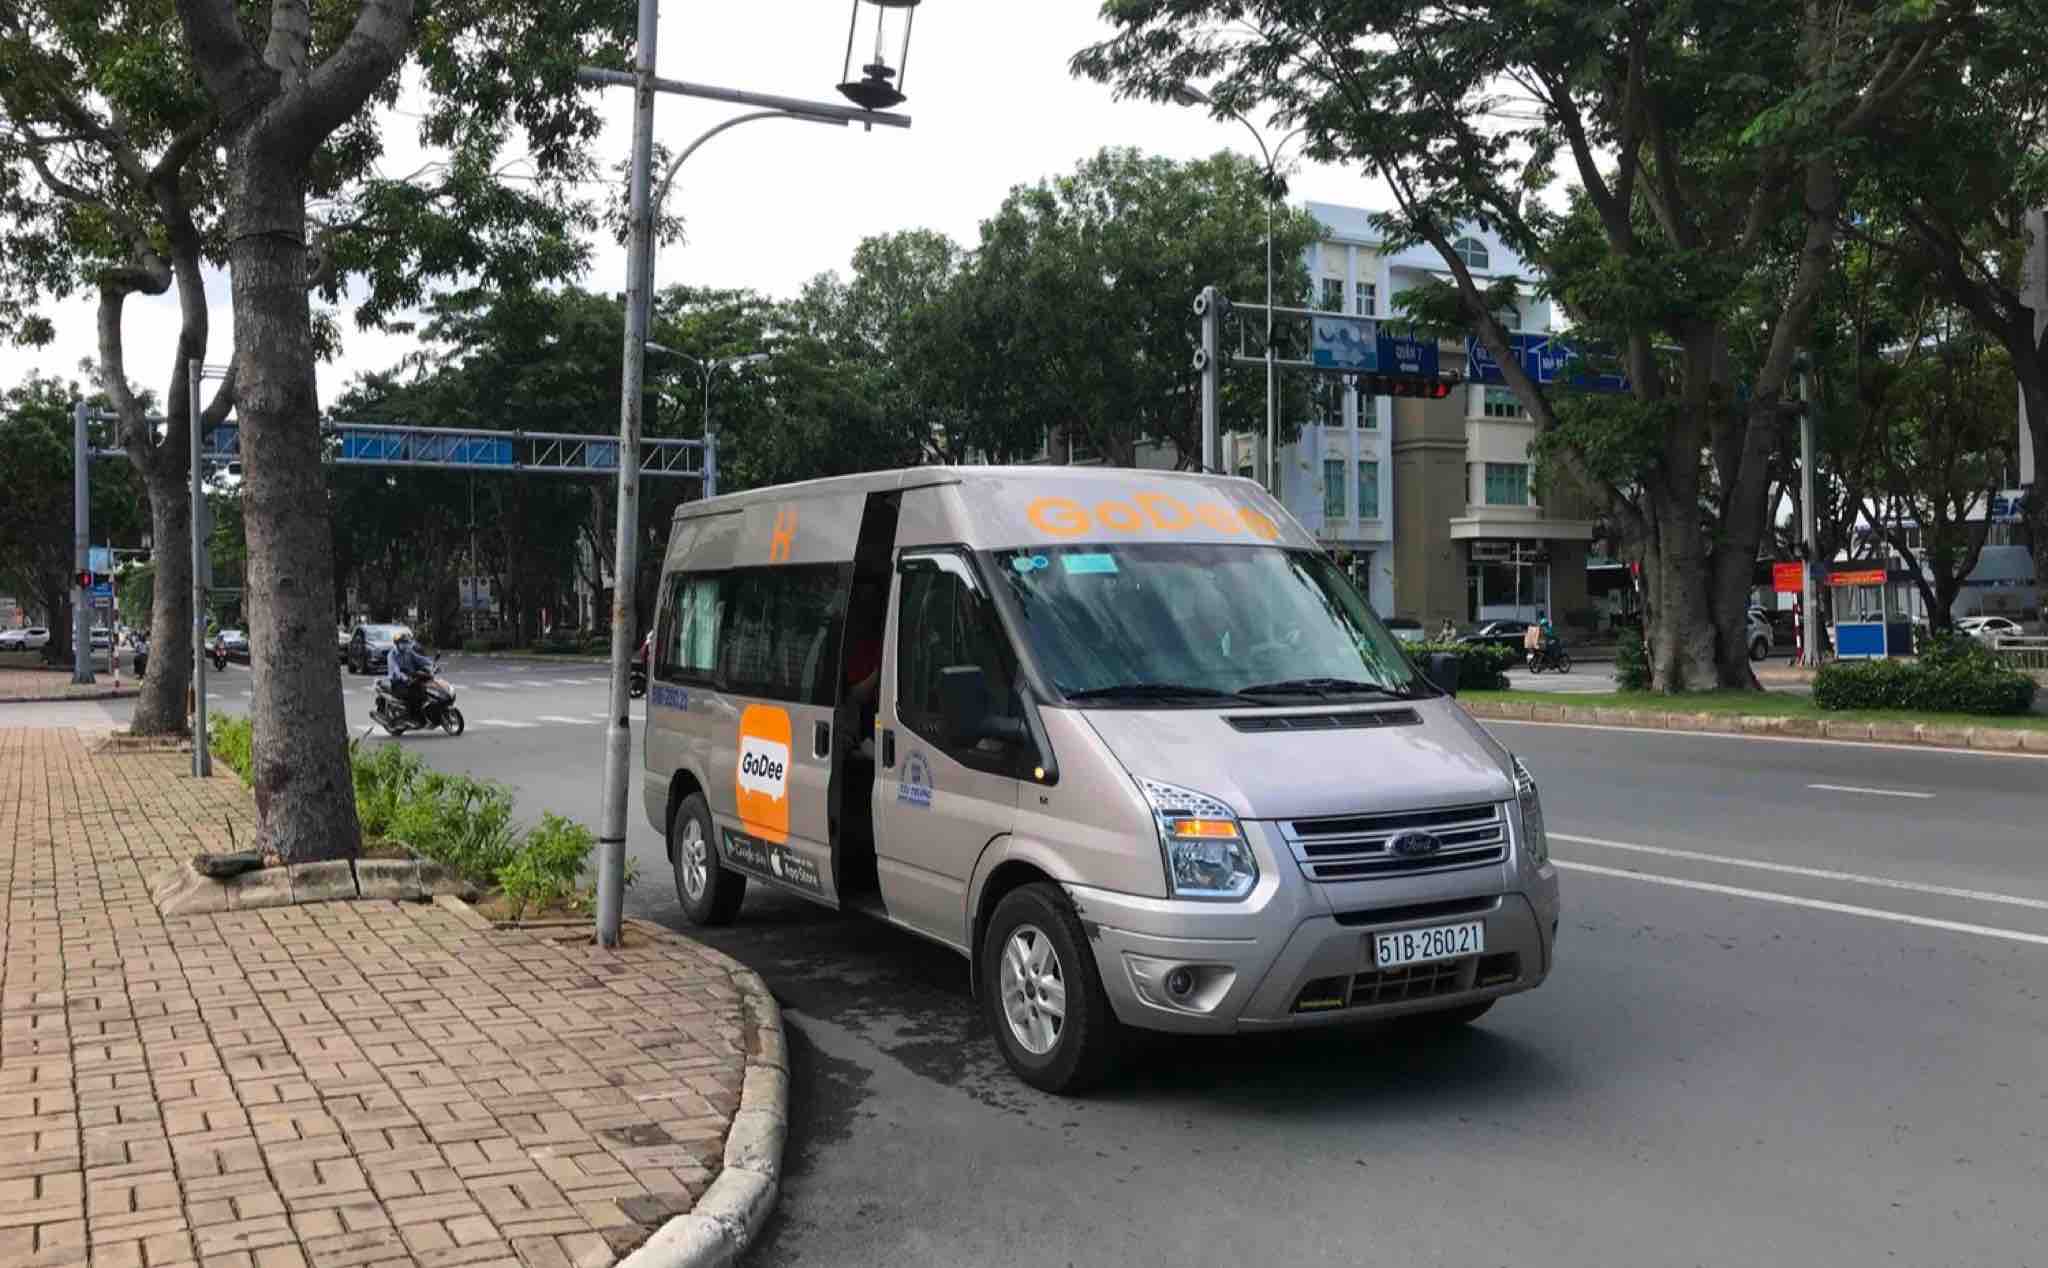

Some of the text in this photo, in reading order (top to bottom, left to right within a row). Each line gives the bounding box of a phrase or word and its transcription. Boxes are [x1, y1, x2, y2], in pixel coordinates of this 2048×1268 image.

[1028, 490, 1278, 540] GoDee
[743, 752, 783, 781] GoDee
[1379, 925, 1479, 964] 51B-260.21
